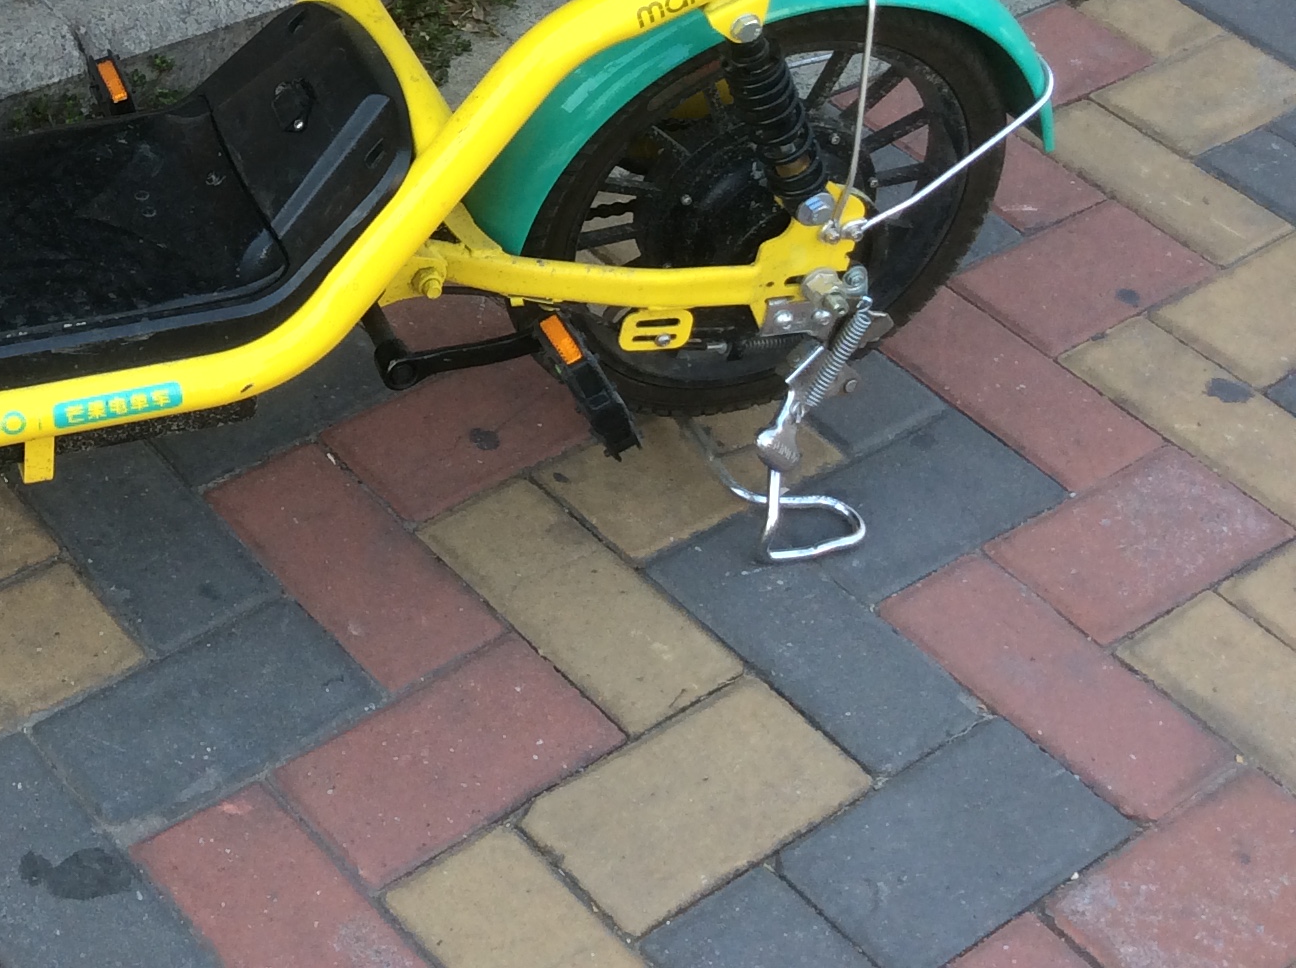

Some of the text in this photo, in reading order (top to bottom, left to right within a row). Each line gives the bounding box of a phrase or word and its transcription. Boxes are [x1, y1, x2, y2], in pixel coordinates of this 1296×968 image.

[63, 388, 172, 425] 芒果电单车
